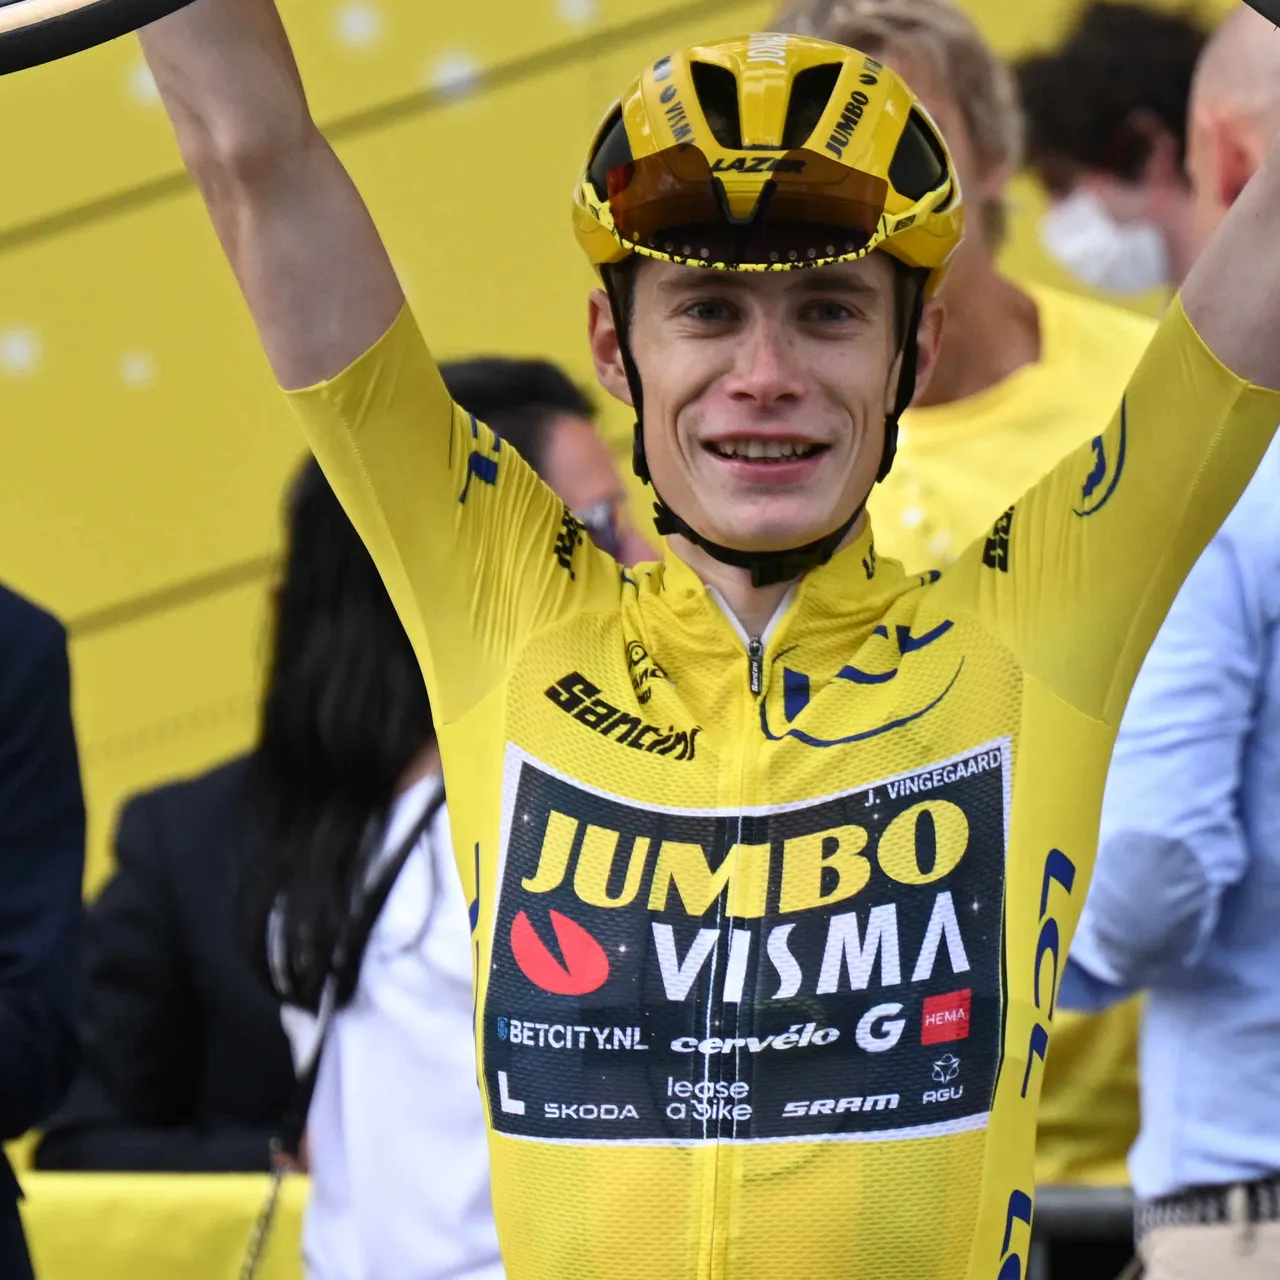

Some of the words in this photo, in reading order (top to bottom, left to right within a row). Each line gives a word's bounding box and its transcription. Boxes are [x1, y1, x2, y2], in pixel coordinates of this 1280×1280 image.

[825, 90, 869, 159] JUMBO
[543, 671, 704, 761] Santini
[864, 789, 882, 807] J.
[886, 750, 1001, 800] VINGEGAARD
[521, 799, 970, 919] JUMBO
[651, 890, 972, 1003] VISMA
[1021, 848, 1076, 1099] LCL
[509, 1019, 649, 1051] BETCITY.NL
[670, 1023, 840, 1054] cervélo
[925, 1008, 966, 1027] HEMA
[666, 1102, 686, 1120] a
[667, 1077, 750, 1099] lease
[782, 1093, 900, 1118] SRAM
[922, 1085, 964, 1105] AGU
